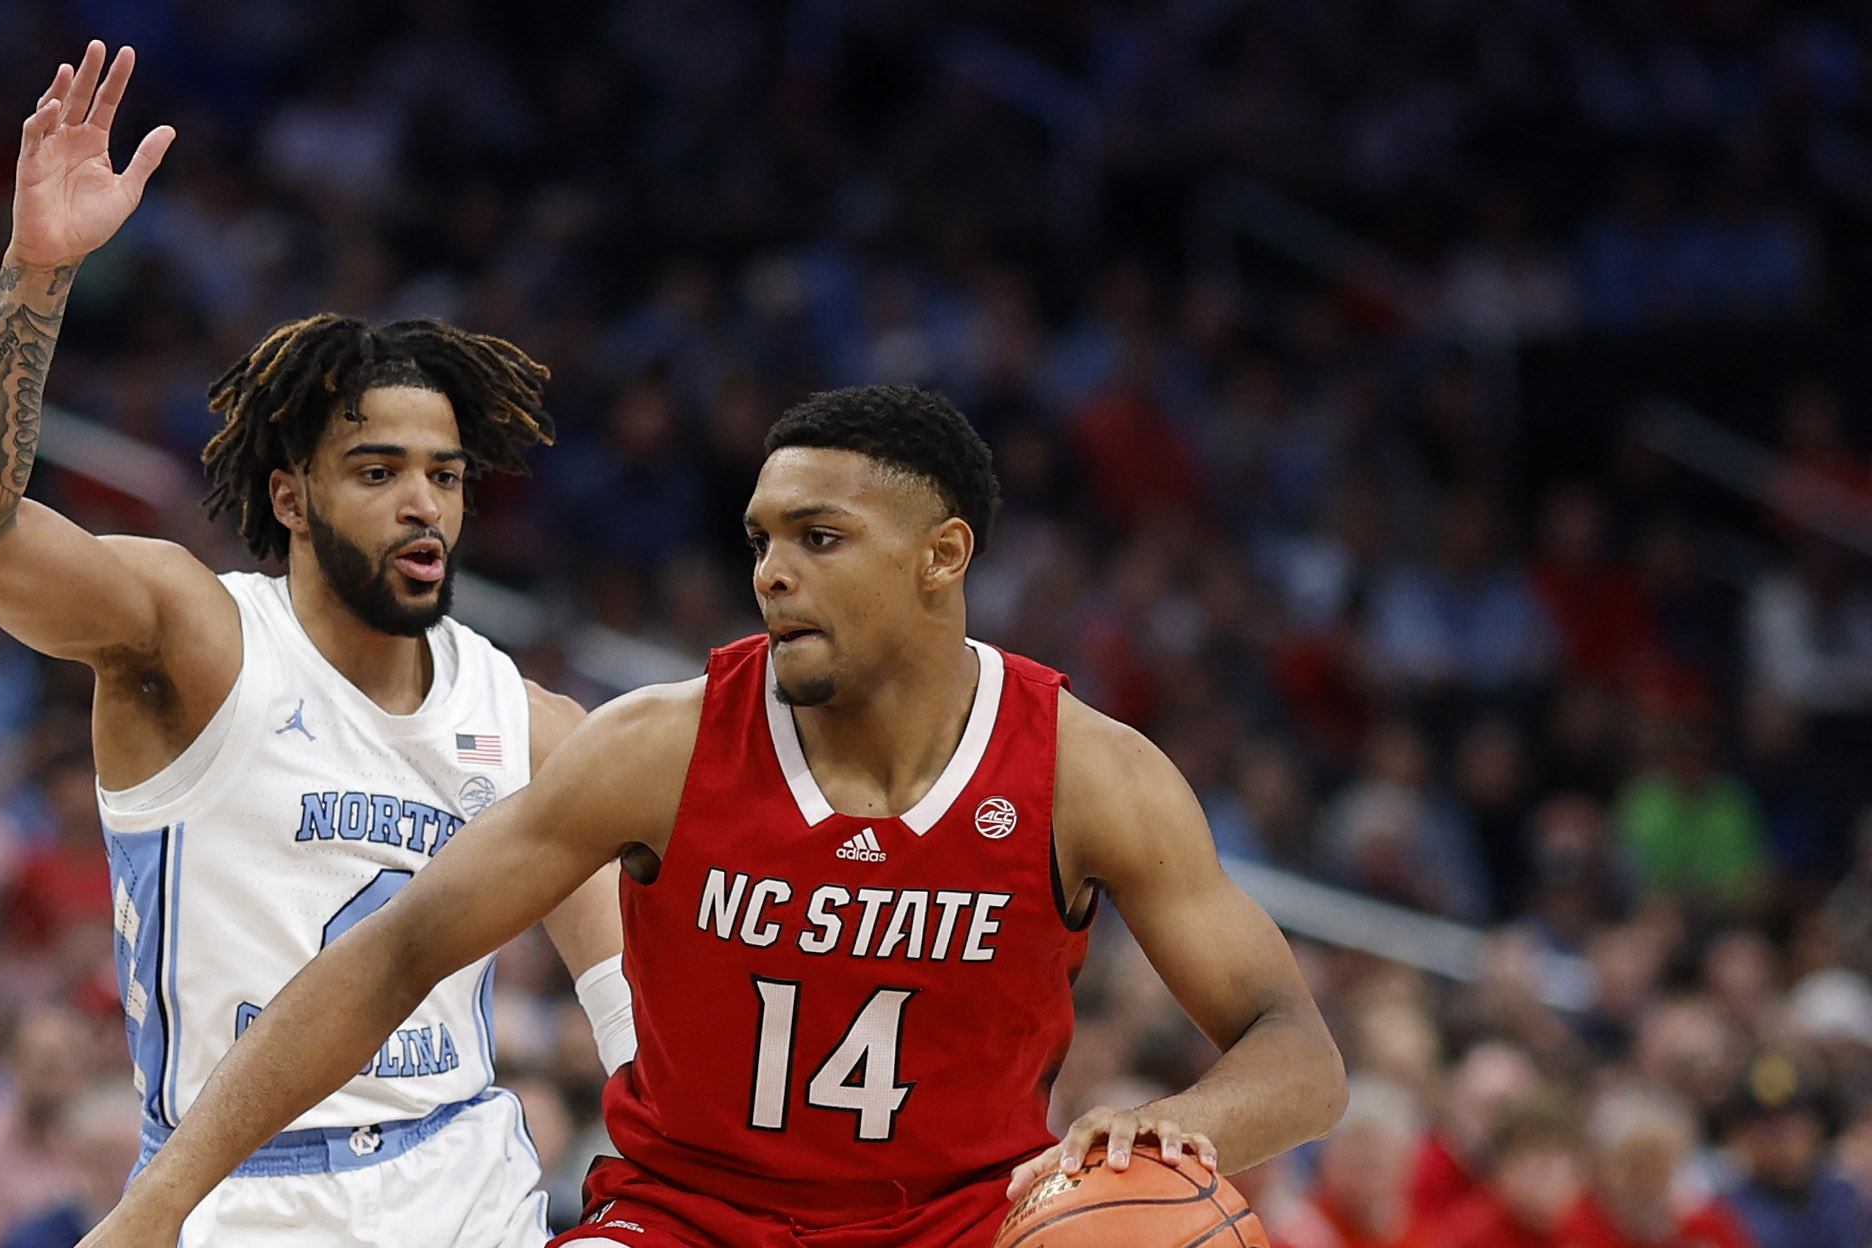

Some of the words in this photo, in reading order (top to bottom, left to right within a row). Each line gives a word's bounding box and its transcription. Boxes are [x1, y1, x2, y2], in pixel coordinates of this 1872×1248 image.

[295, 791, 466, 857] NORTH
[978, 810, 1016, 823] ACC
[835, 847, 887, 862] adidas
[697, 867, 792, 949] NC
[797, 883, 1013, 962] STATE
[747, 974, 922, 1142] 14
